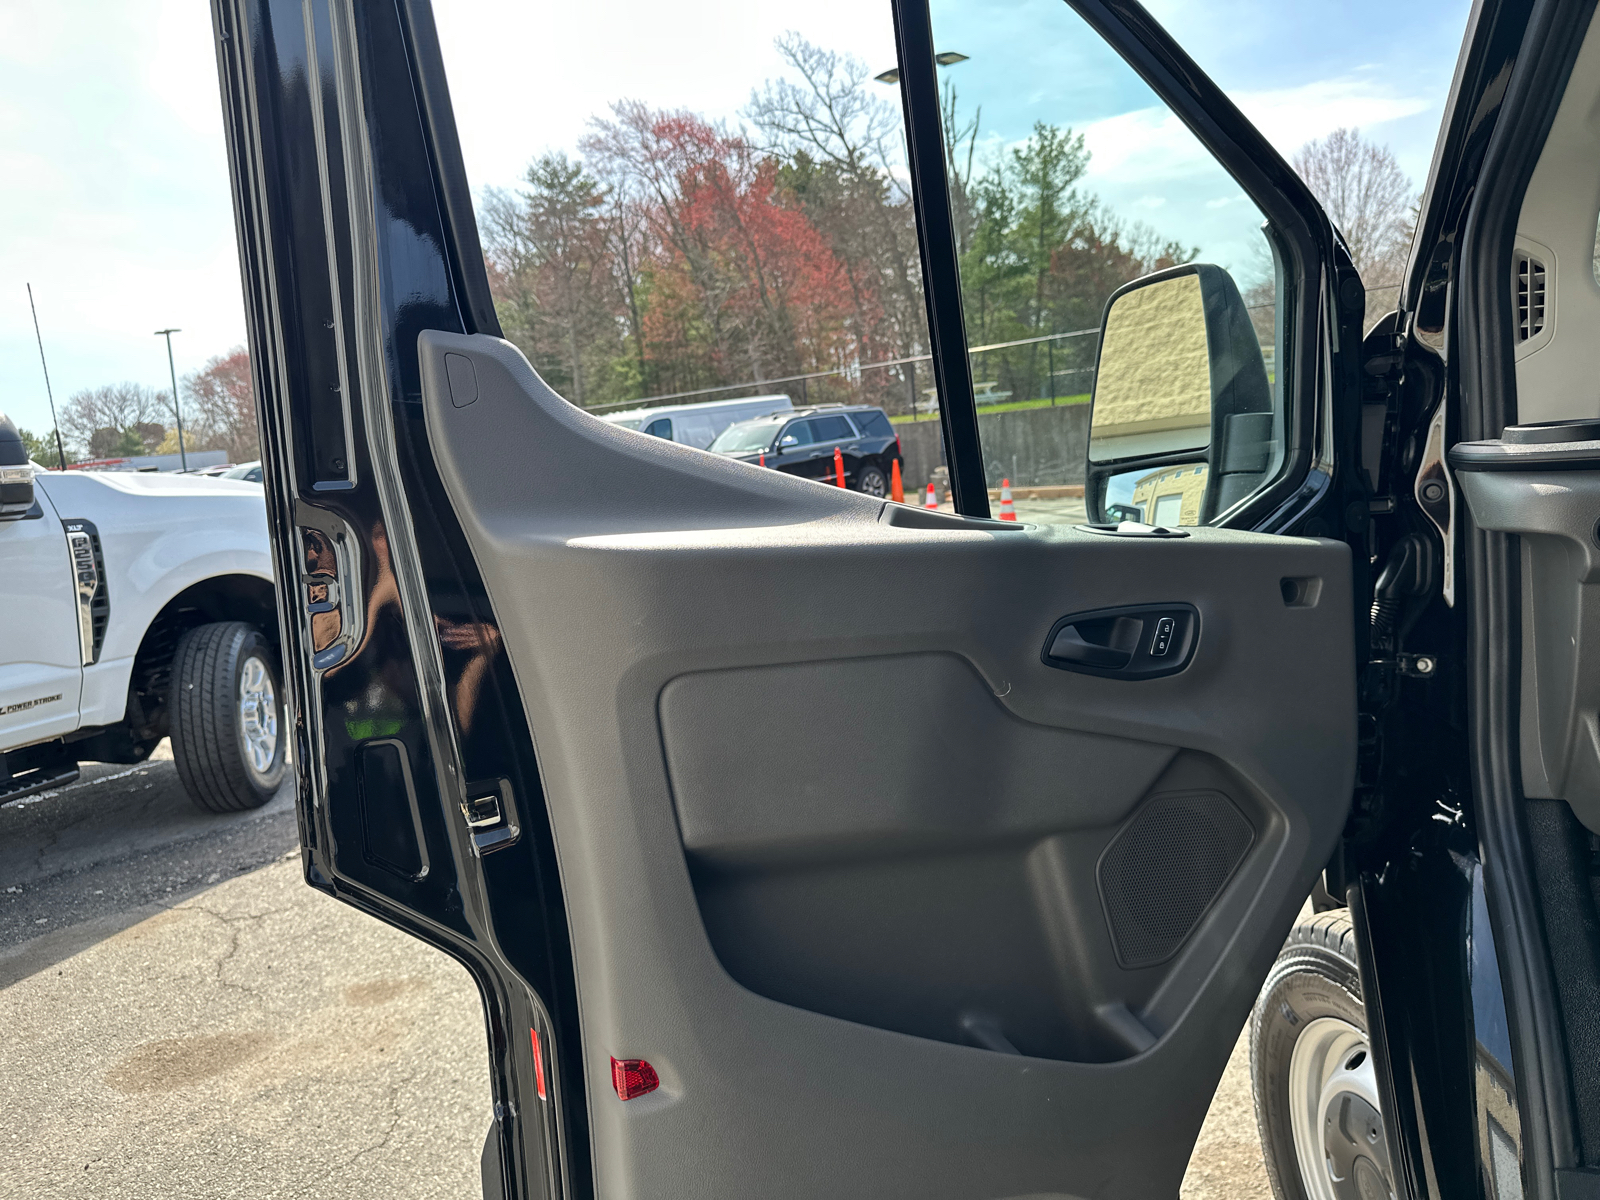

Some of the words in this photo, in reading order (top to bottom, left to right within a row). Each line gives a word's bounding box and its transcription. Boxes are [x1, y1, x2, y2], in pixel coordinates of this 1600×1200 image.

[67, 524, 83, 532] XLT
[7, 700, 33, 714] POWER
[33, 693, 63, 706] STROKE
